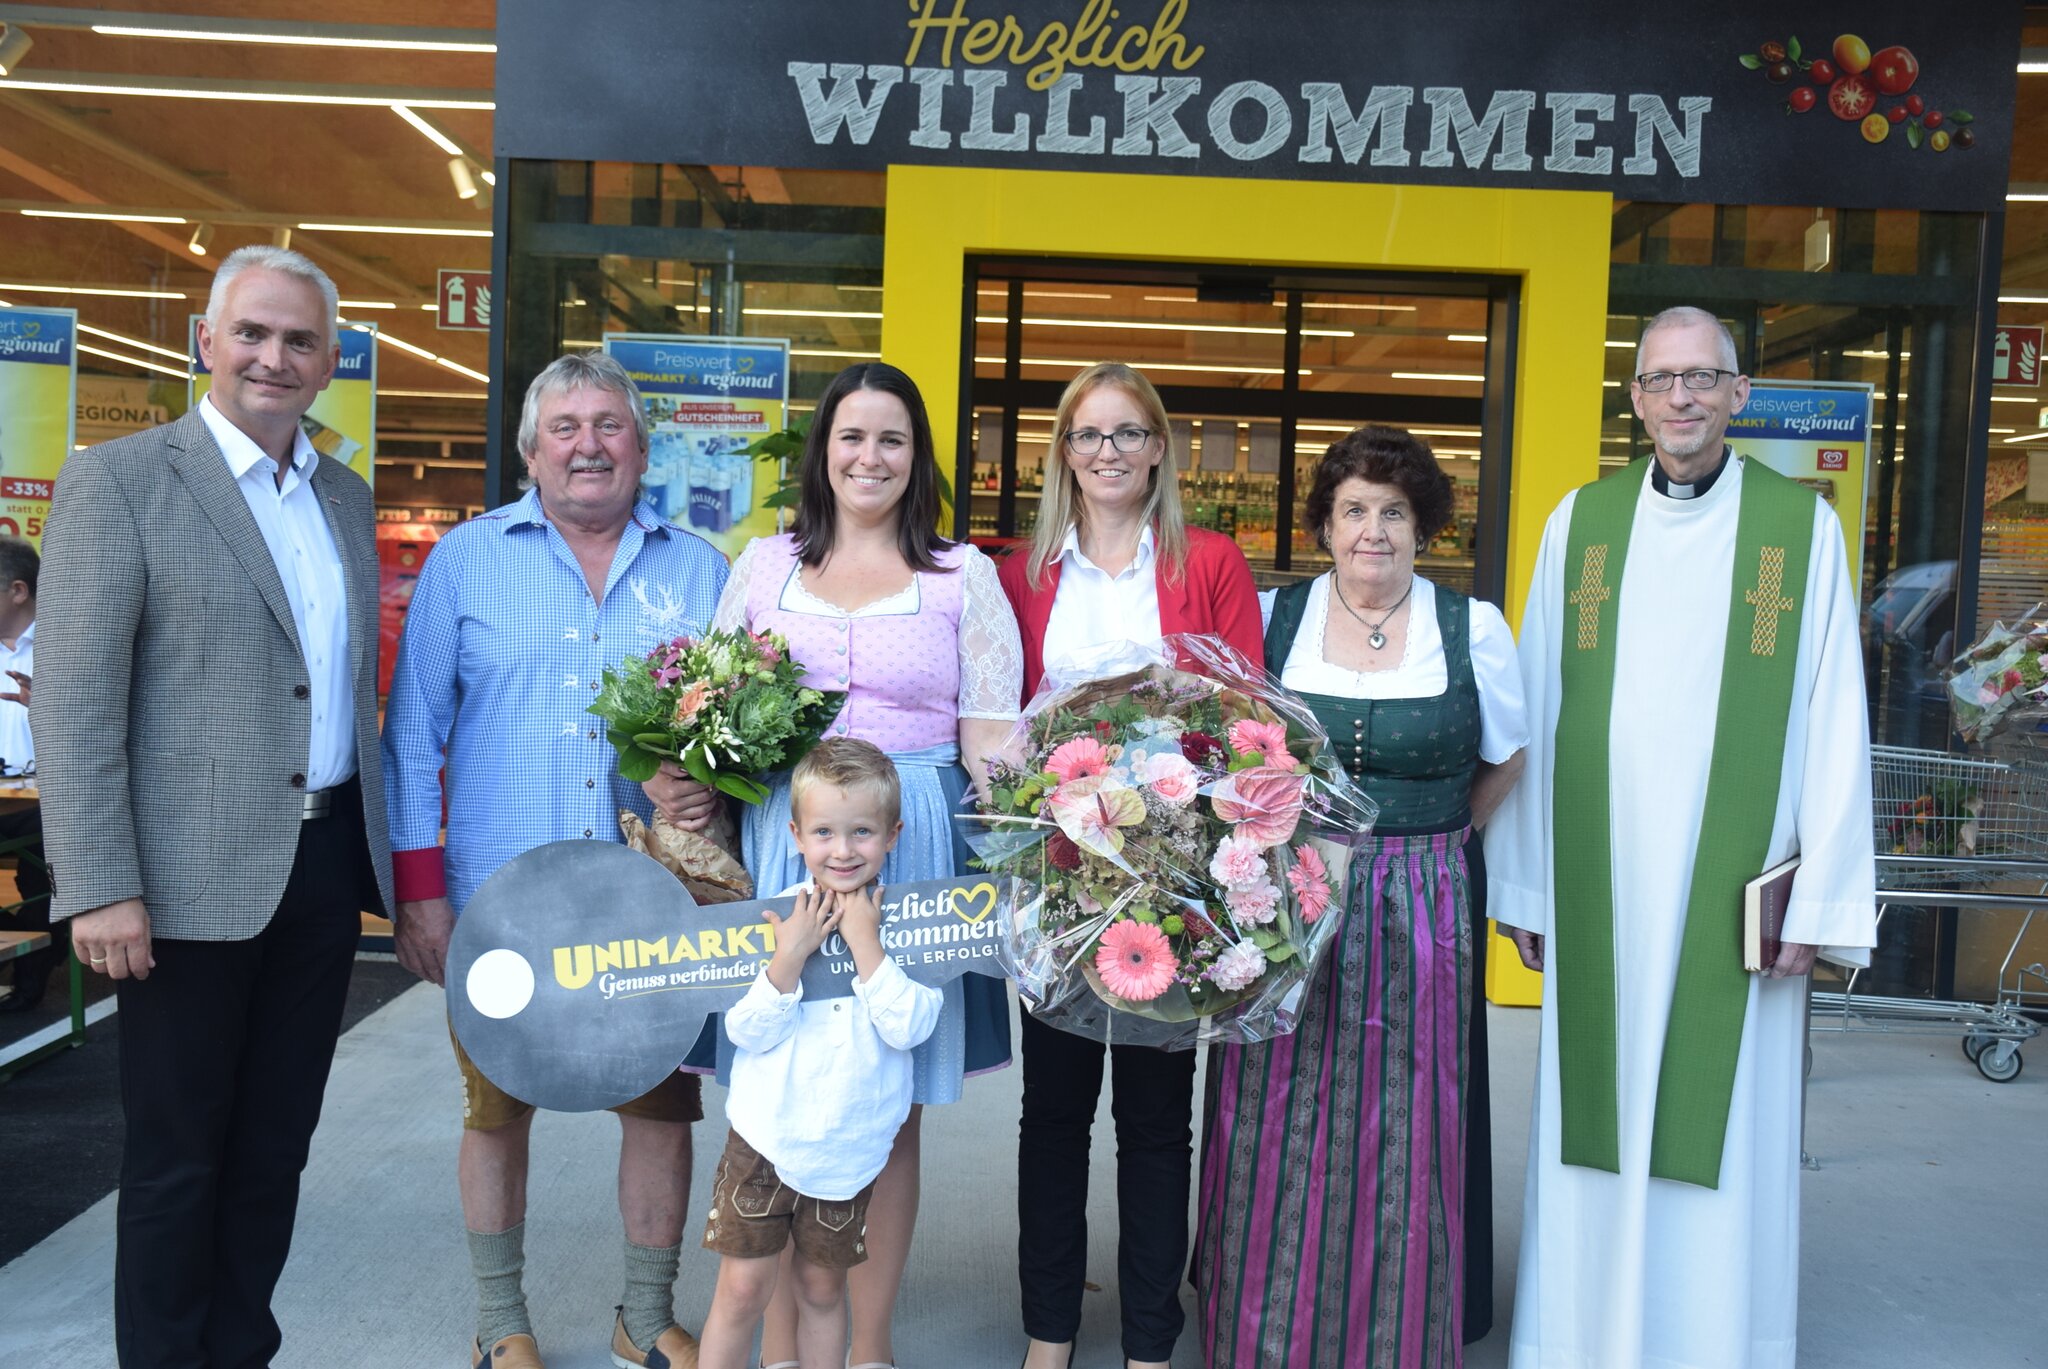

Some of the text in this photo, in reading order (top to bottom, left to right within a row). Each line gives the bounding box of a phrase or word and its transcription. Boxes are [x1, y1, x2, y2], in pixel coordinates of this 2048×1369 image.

[905, 0, 1204, 90] Herzlich
[787, 61, 1713, 178] WILLKOMMEN
[0, 336, 65, 355] egional
[654, 350, 732, 370] Preiswert
[703, 371, 778, 391] regional
[1746, 396, 1814, 413] reiswert
[76, 405, 165, 425] EGIONAL
[676, 412, 762, 423] GUTSCHEINHEFT
[1783, 414, 1860, 434] regional
[6, 481, 50, 498] -33%
[6, 505, 32, 515] statt
[881, 888, 952, 923] zlich
[552, 923, 777, 990] UNIMARKT
[830, 943, 1000, 975] UN EL ERFOLG!
[598, 960, 758, 1000] Genuss verbindet
